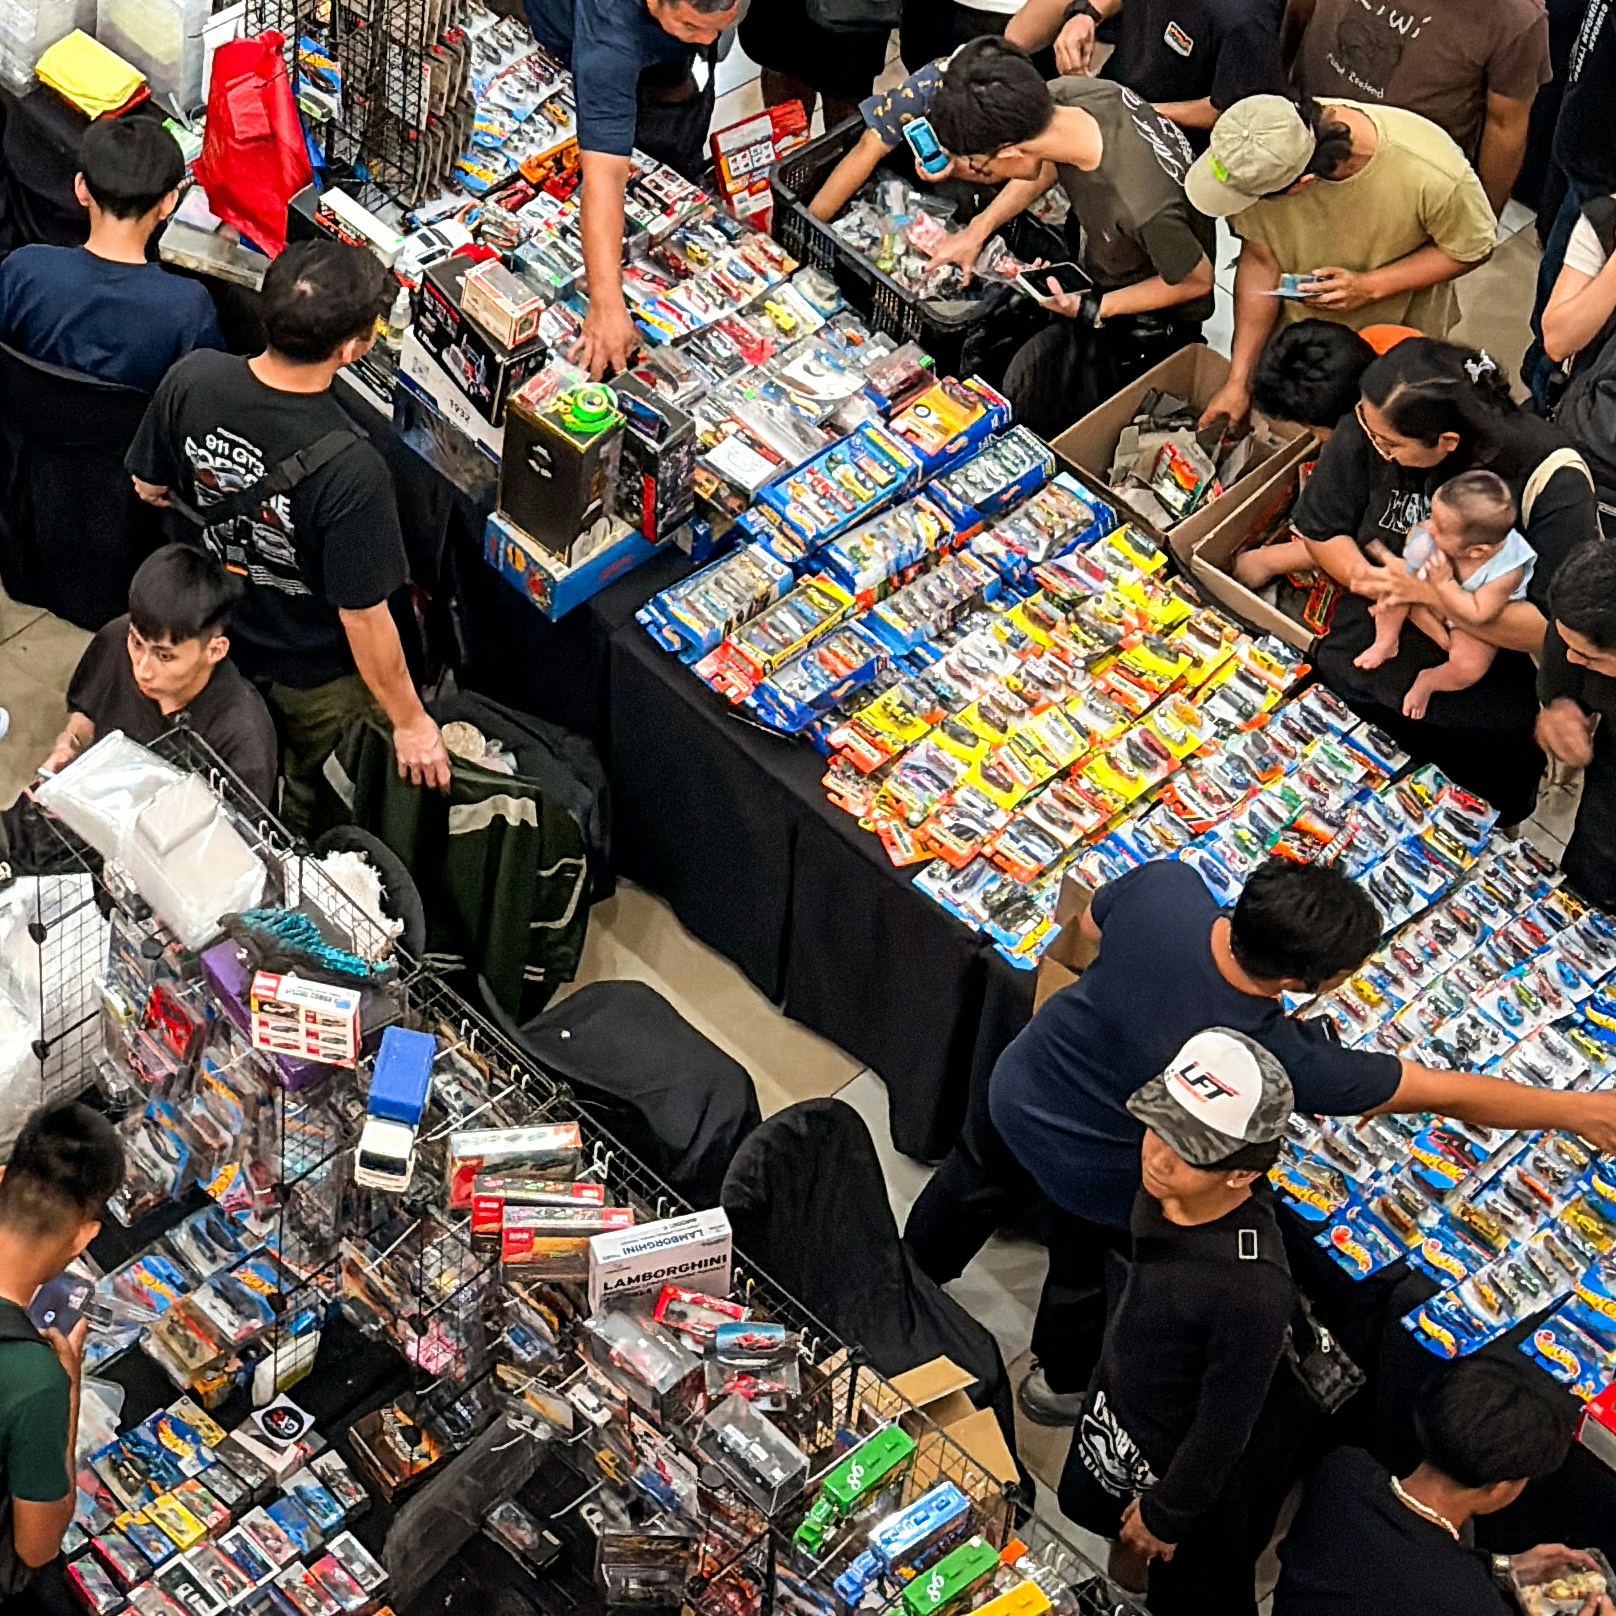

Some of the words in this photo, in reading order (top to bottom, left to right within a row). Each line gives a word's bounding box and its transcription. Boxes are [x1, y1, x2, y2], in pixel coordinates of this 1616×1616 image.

[448, 397, 473, 424] 1932
[205, 433, 230, 456] 911
[621, 1228, 705, 1257] LAMBORGHINI
[602, 1253, 728, 1291] LAMBORGHINI
